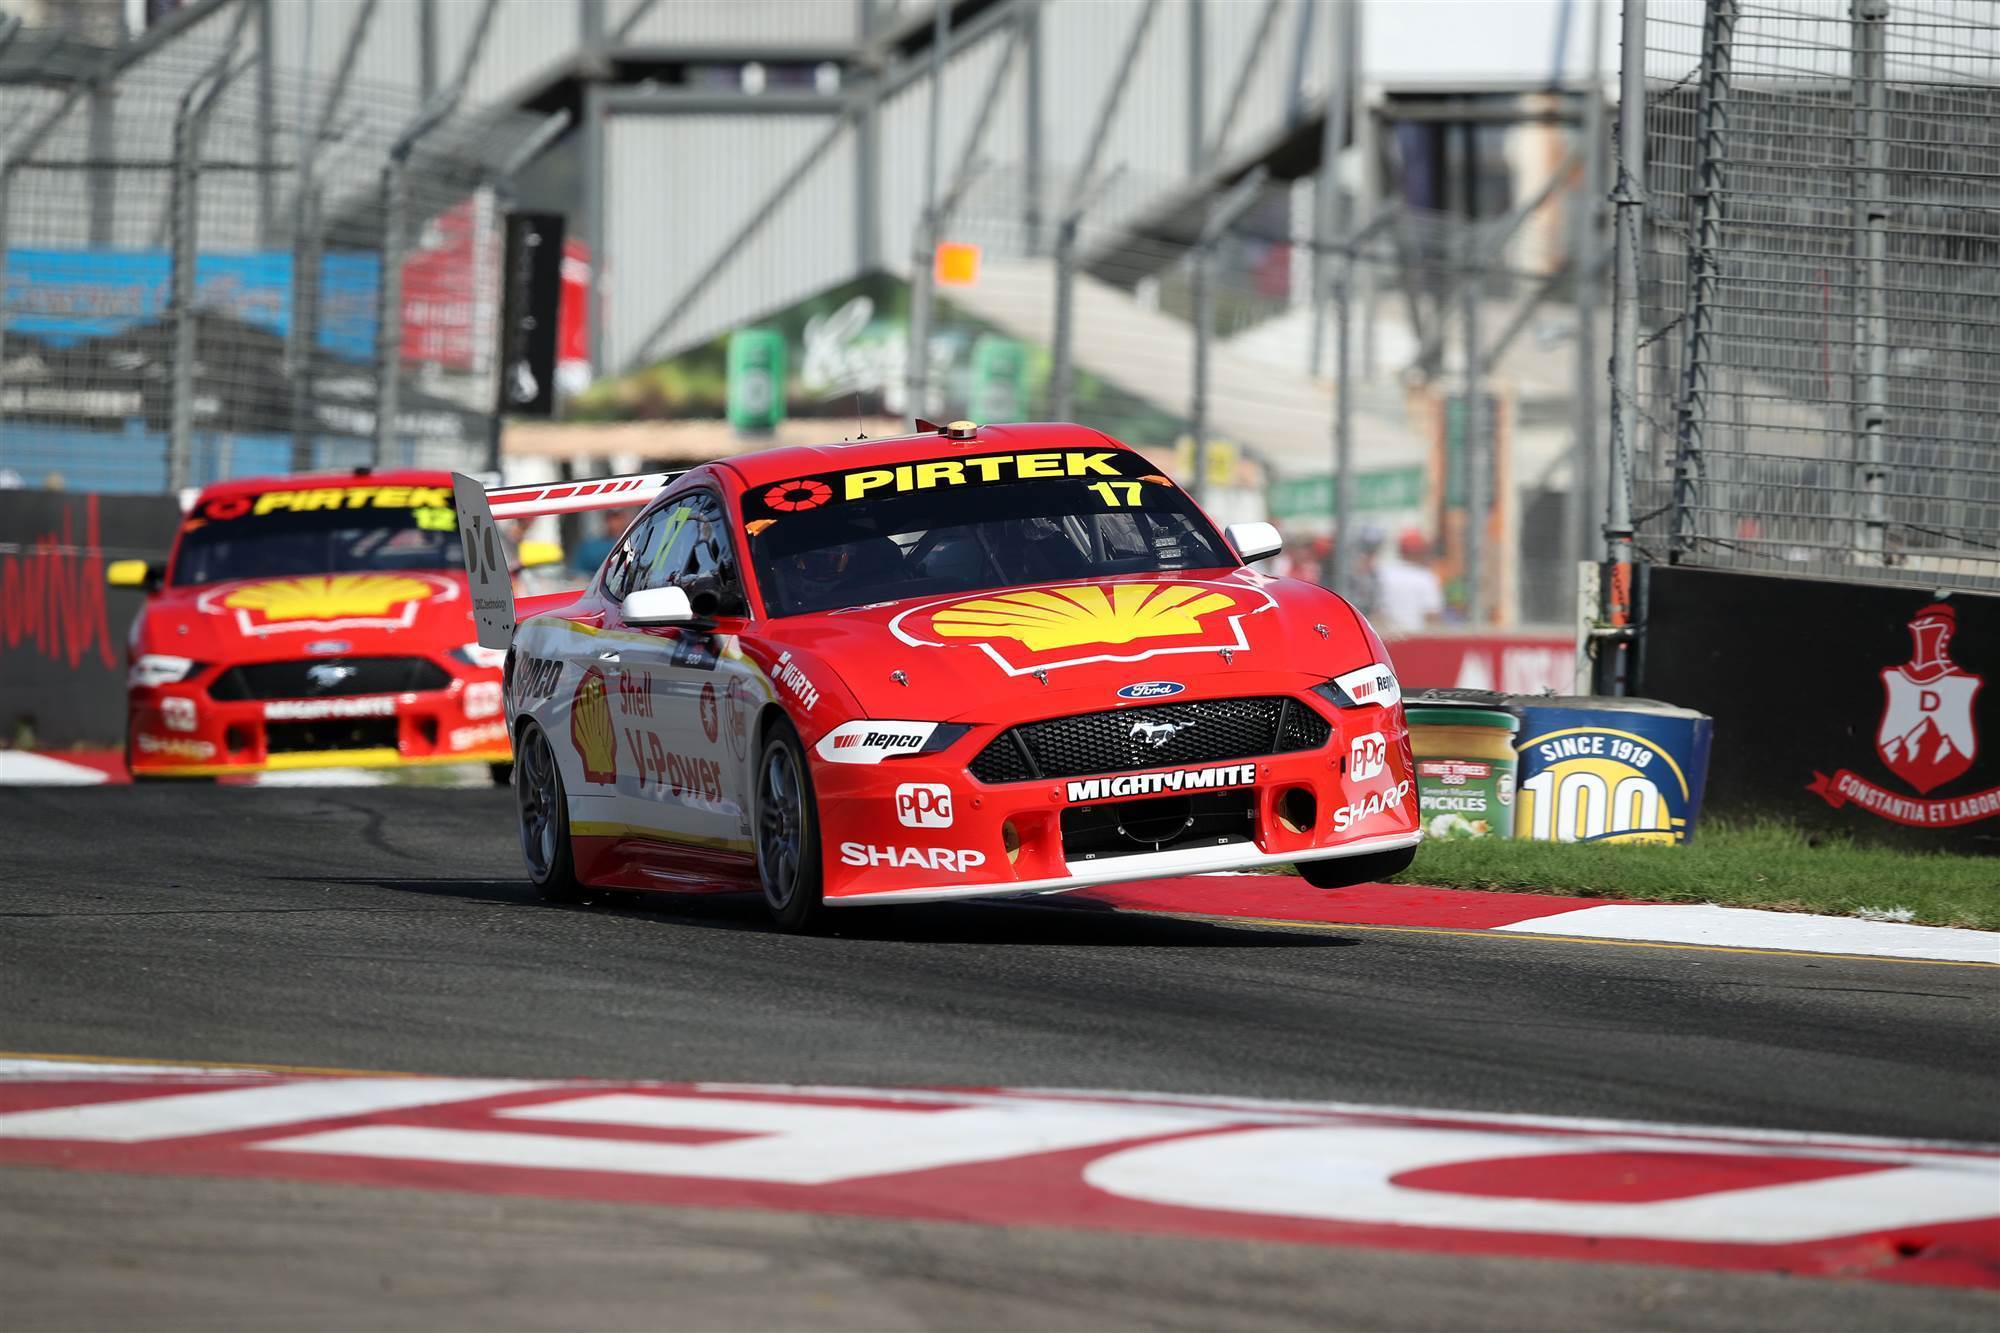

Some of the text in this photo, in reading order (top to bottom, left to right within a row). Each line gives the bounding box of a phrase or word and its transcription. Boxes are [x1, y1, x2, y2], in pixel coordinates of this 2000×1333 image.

[845, 453, 1122, 500] PIRTEK
[254, 487, 450, 515] PIRTEK
[1087, 481, 1143, 507] 17
[619, 668, 653, 718] Shell
[1130, 683, 1172, 697] Ford
[1919, 690, 1942, 713] D
[862, 732, 923, 749] Repco
[1540, 736, 1654, 768] SINCE 1919
[624, 727, 722, 803] V-Power
[1333, 779, 1410, 832] SHARP
[1420, 796, 1487, 812] PICKLES
[1522, 771, 1660, 842] 100
[1838, 774, 1926, 822] CONSTANTIA
[1929, 804, 1946, 822] ET
[840, 842, 986, 872] SHARP
